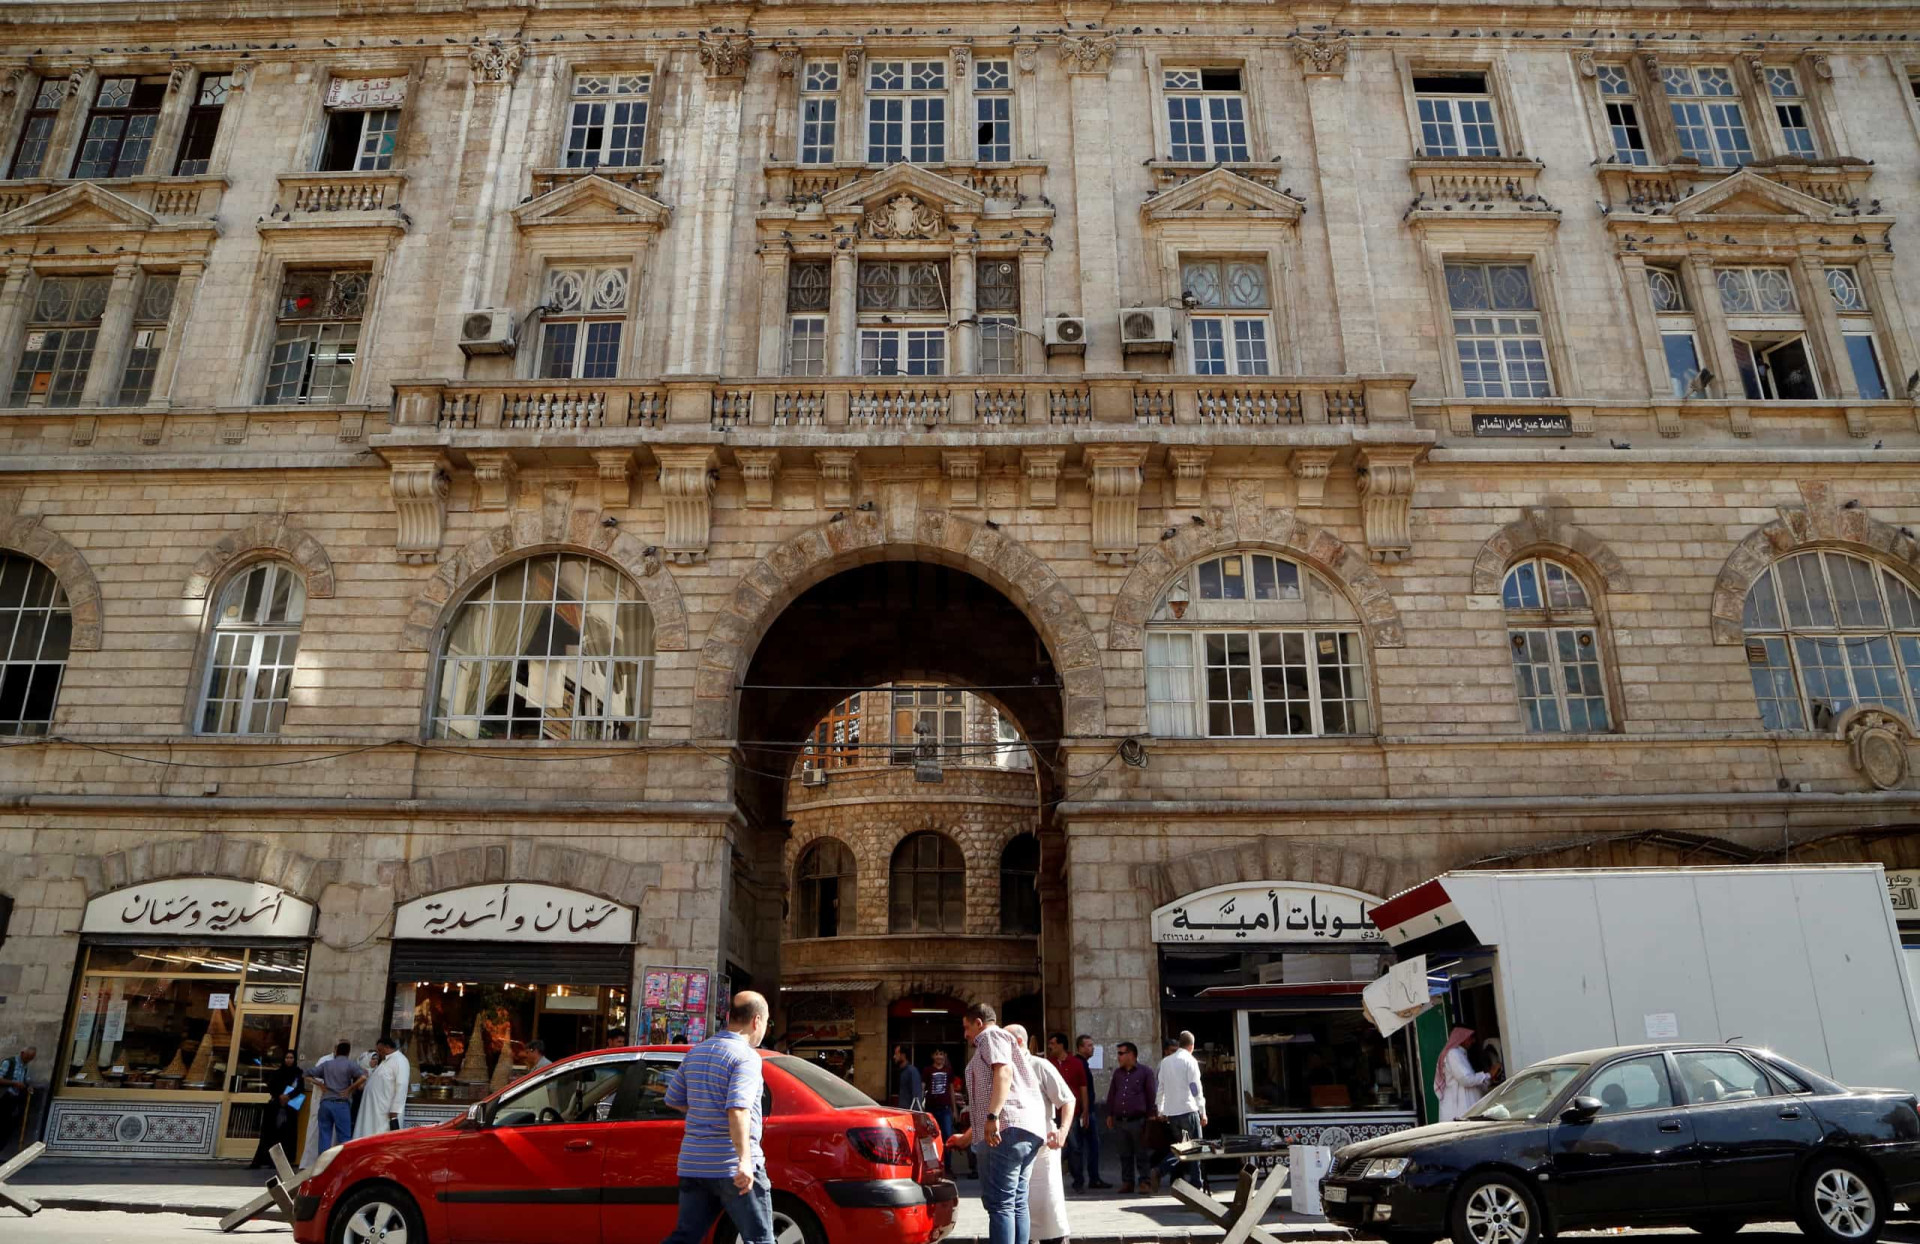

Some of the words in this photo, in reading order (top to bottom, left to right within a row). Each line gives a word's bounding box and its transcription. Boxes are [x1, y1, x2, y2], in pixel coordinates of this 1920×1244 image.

[356, 77, 391, 92] فندق
[339, 93, 369, 107] الكبير
[1477, 416, 1506, 434] الشمالي
[1505, 418, 1523, 432] كامل
[1524, 420, 1539, 433] عبير
[1539, 418, 1567, 432] المحامية
[506, 915, 525, 933] و
